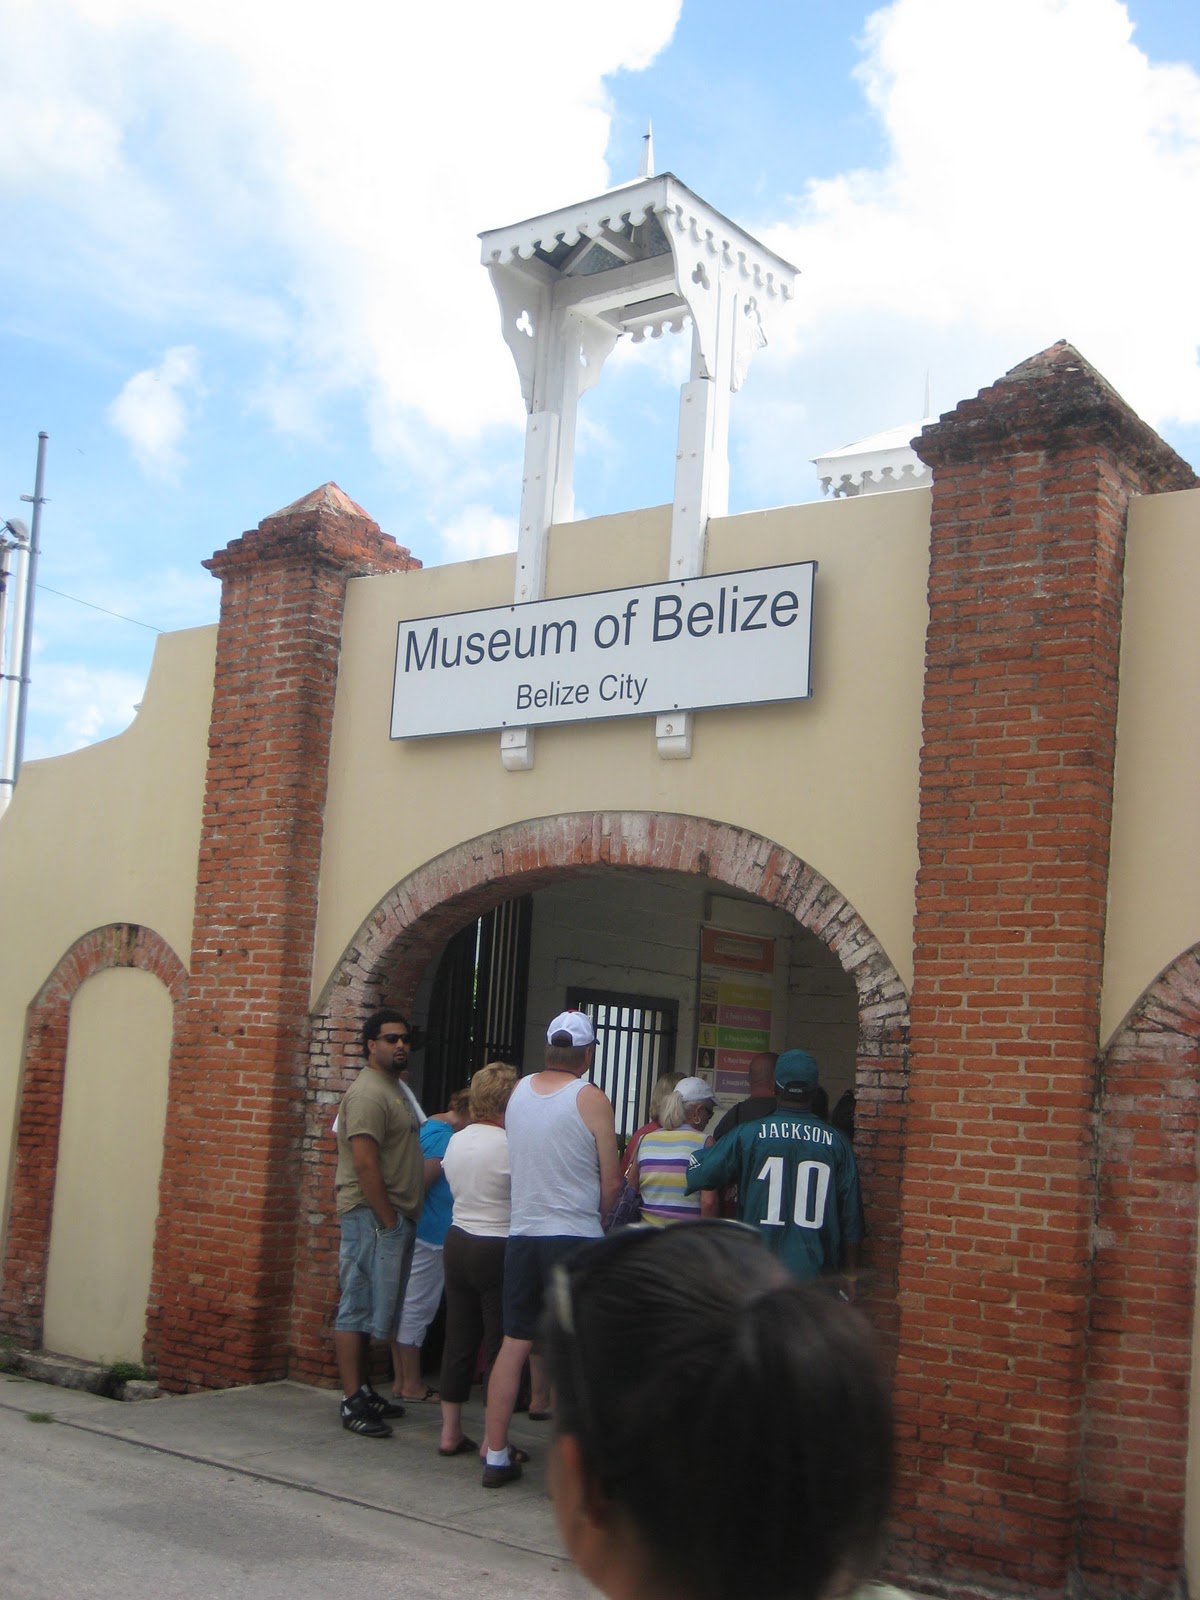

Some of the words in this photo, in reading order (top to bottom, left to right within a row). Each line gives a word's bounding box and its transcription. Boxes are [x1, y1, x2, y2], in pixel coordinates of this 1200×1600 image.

[404, 618, 577, 673] Museum
[593, 599, 639, 649] of
[652, 585, 799, 643] Belize
[516, 680, 590, 709] Belize
[598, 673, 648, 705] City
[758, 1122, 834, 1146] JACKSON
[757, 1156, 831, 1230] 10
